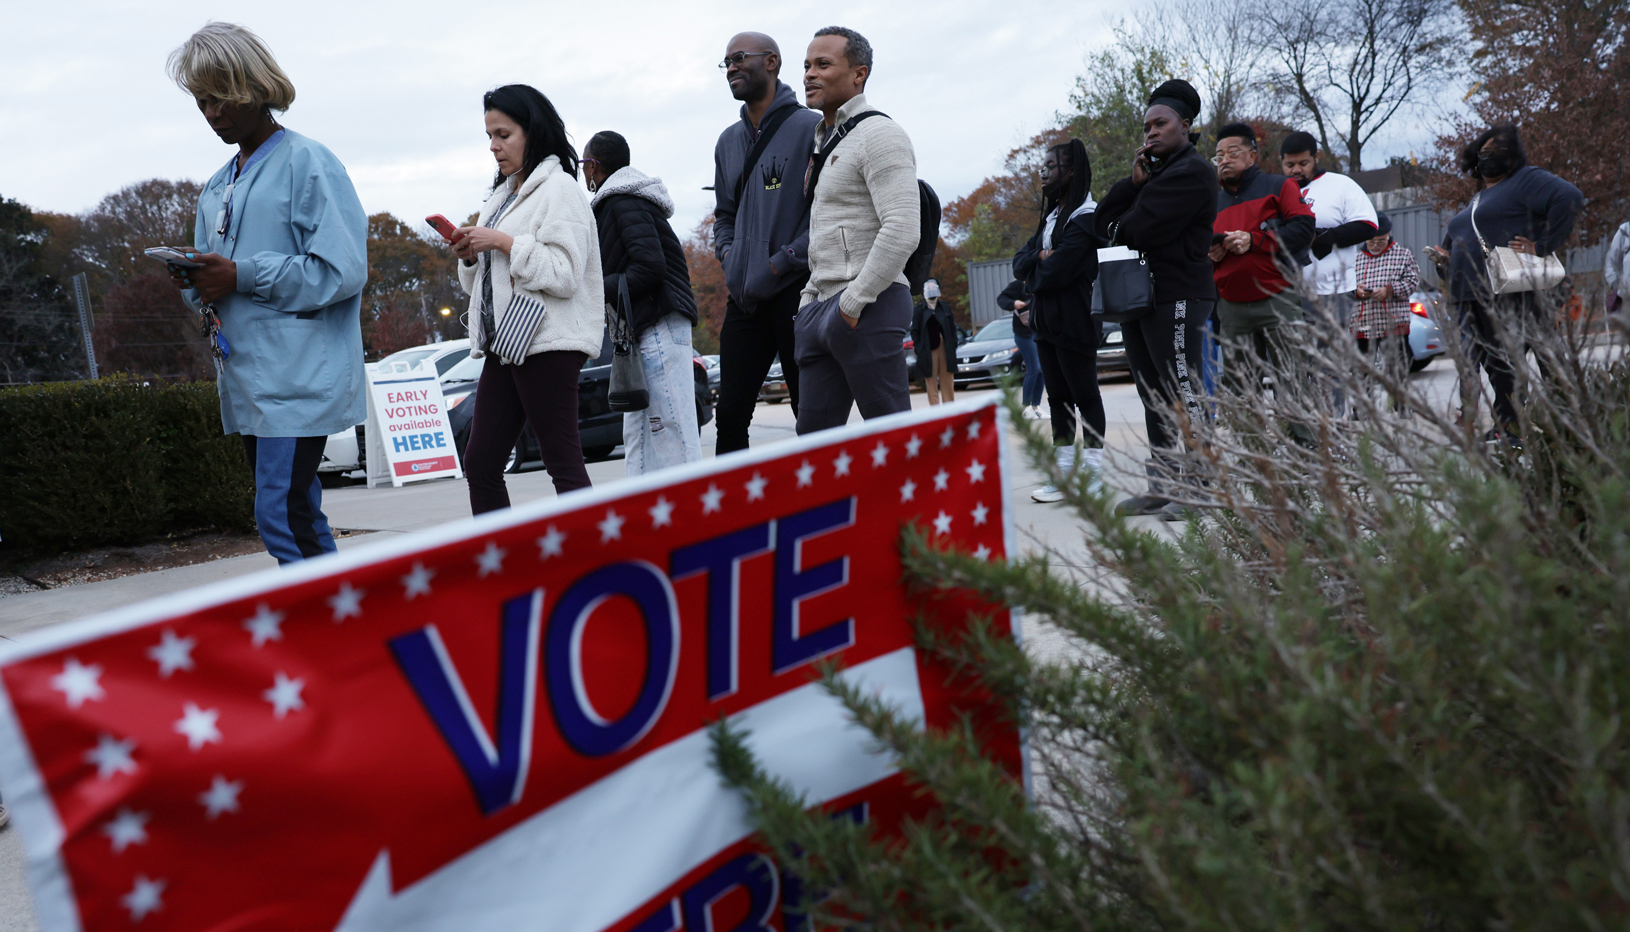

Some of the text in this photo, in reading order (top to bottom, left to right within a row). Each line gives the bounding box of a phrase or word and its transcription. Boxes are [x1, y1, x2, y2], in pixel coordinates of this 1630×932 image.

[1175, 300, 1186, 319] INK
[387, 390, 428, 403] EARLY
[385, 404, 438, 418] VOTING
[389, 419, 441, 432] available
[392, 432, 446, 453] HERE
[387, 495, 857, 816] VOTE
